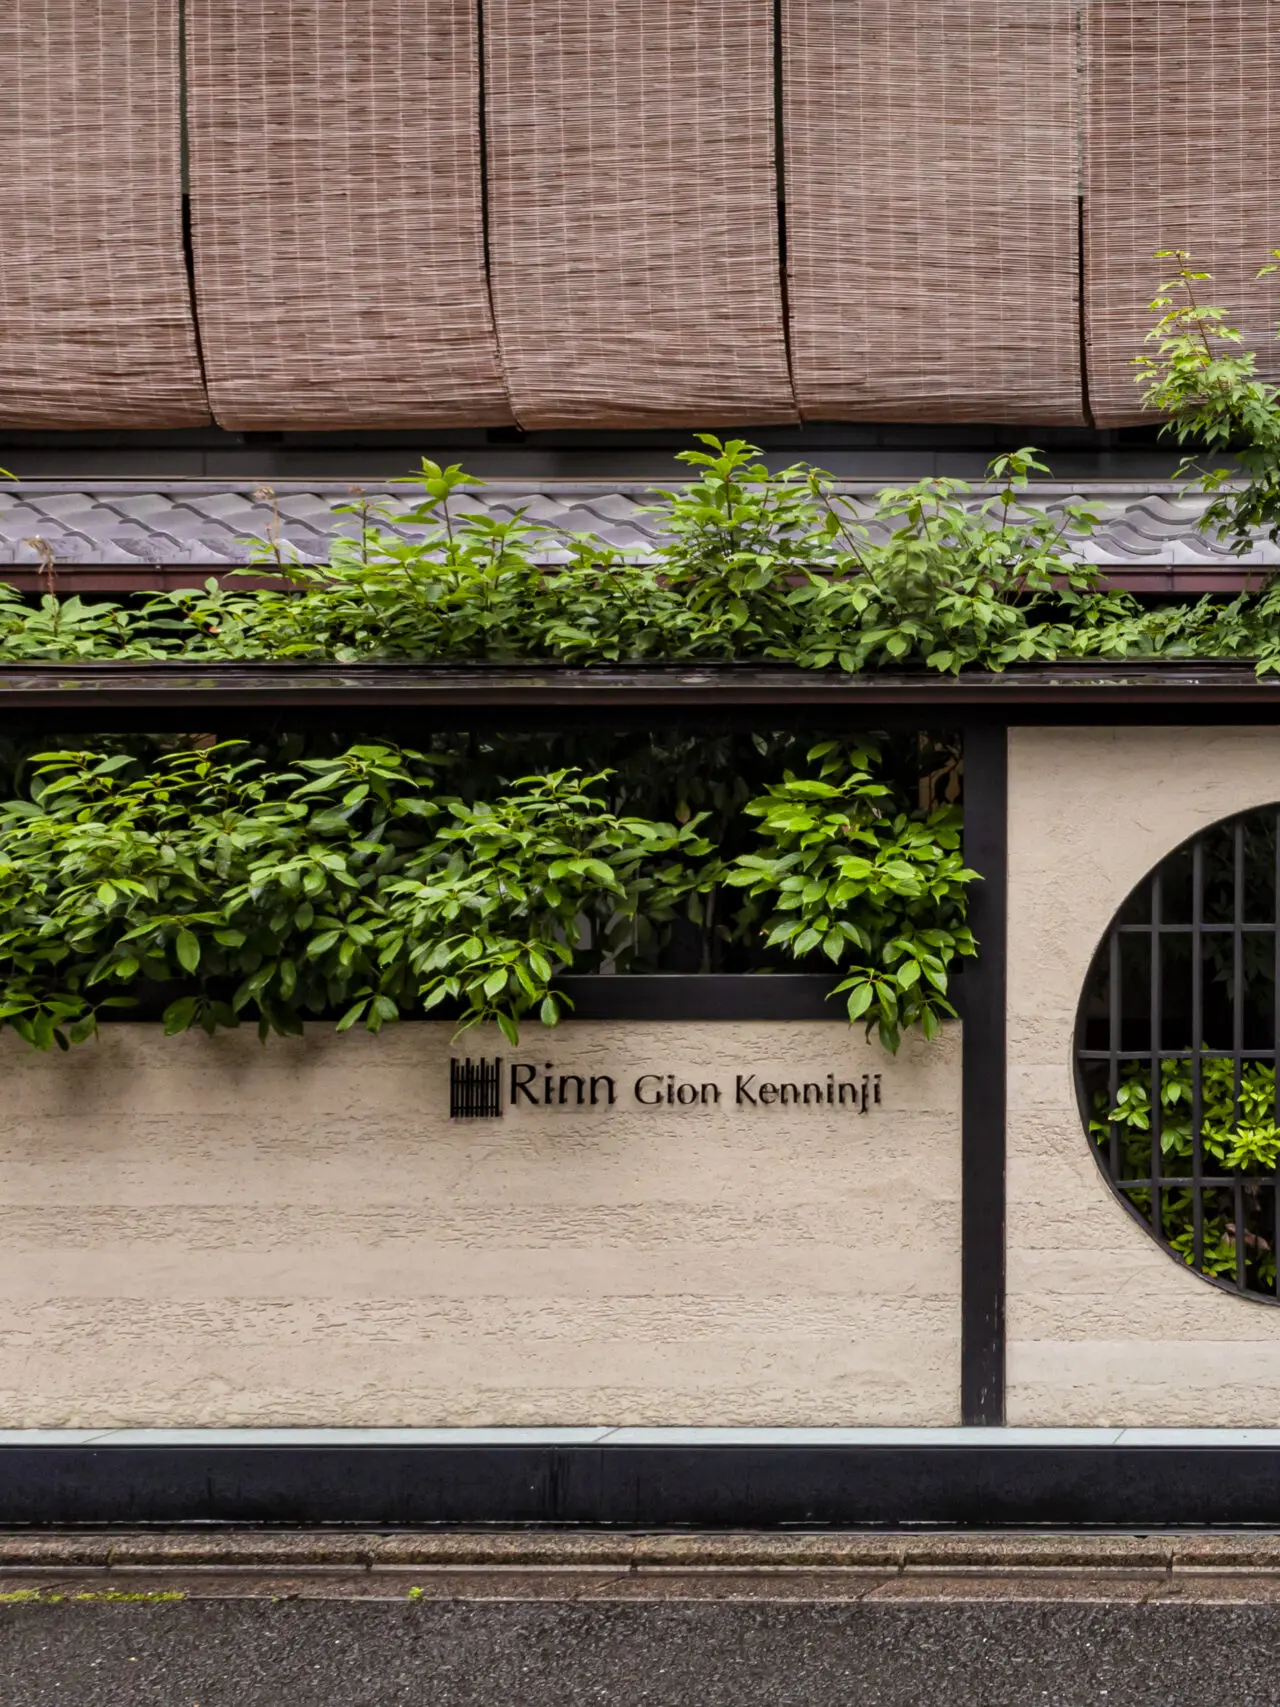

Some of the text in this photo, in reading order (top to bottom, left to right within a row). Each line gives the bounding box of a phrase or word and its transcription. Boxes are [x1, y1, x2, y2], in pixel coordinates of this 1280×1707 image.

[509, 1062, 883, 1114] Rinn Gion Kenninji
